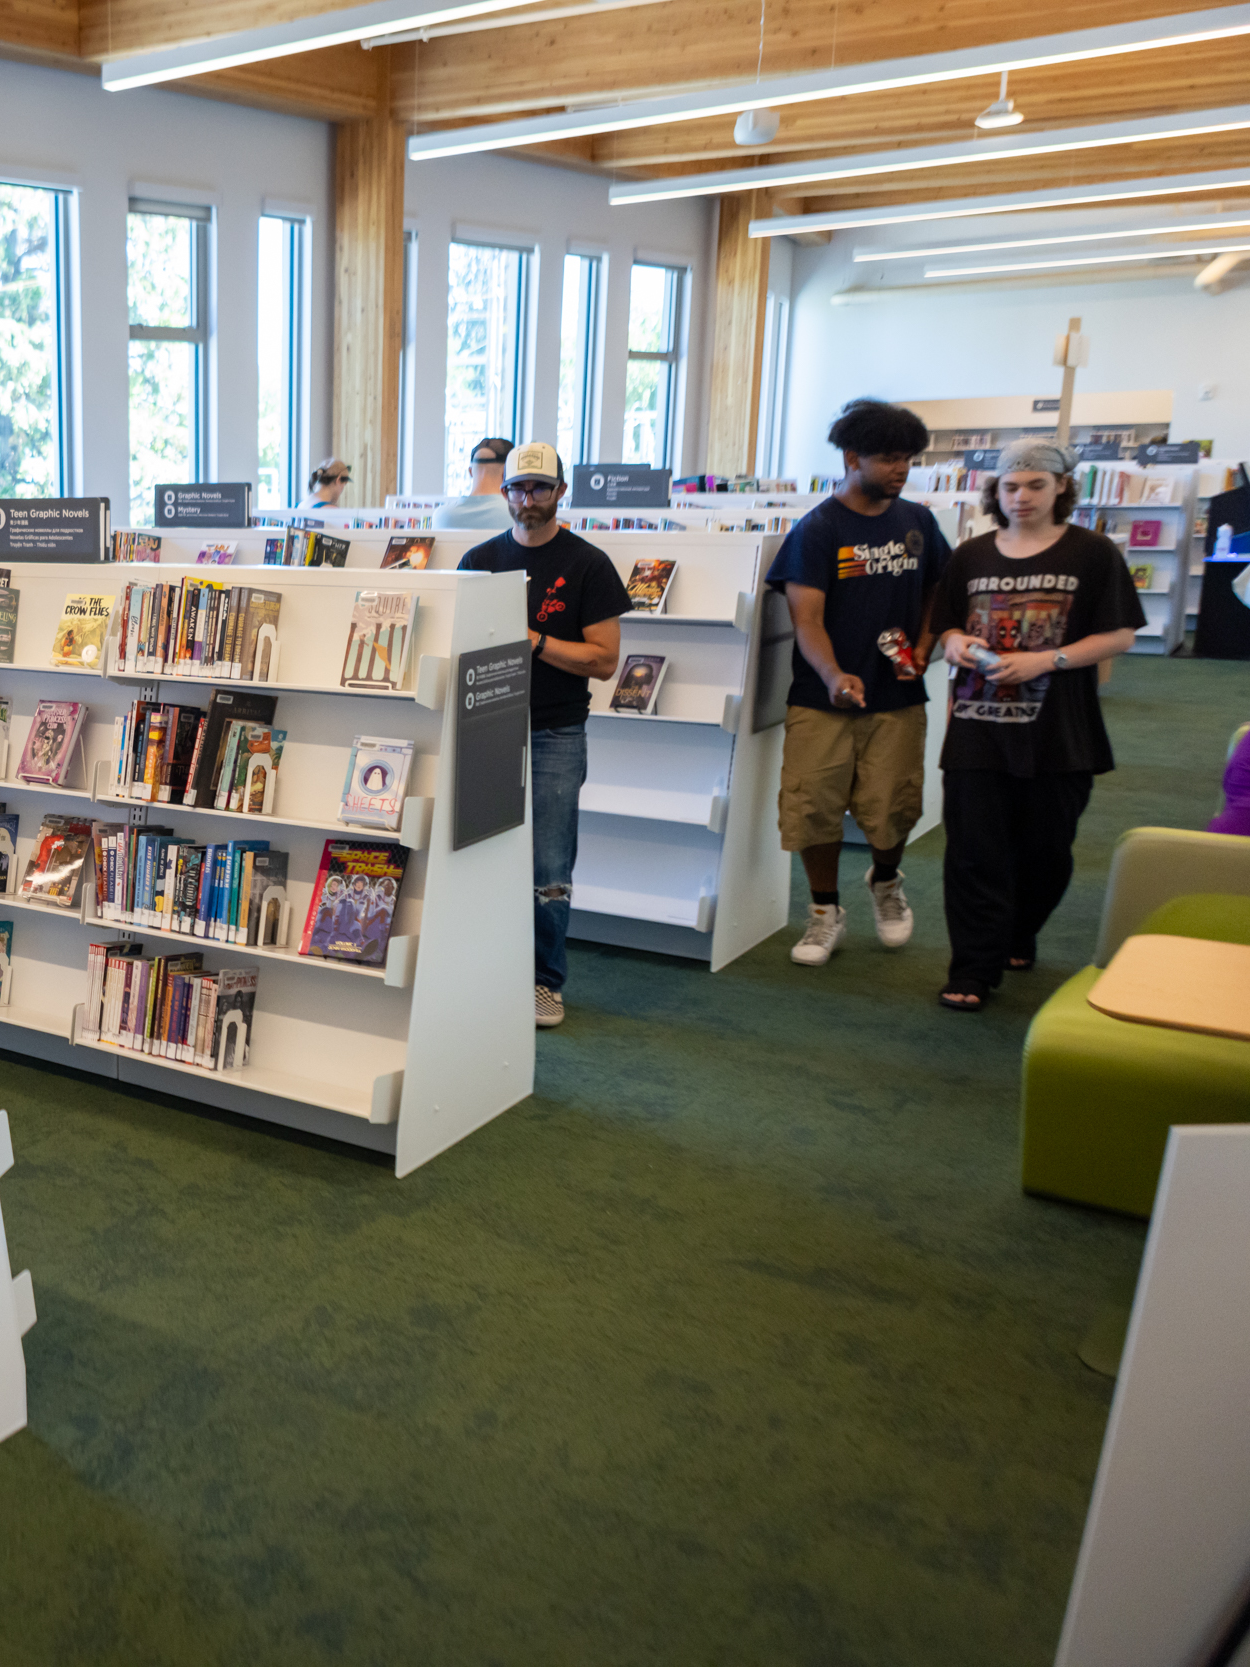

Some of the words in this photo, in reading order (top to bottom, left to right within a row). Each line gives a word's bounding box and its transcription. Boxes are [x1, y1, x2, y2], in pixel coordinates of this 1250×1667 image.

[10, 509, 28, 518] Teen
[30, 509, 60, 519] Graphic
[62, 509, 89, 518] Novels
[853, 540, 906, 561] Single
[865, 555, 918, 577] Origin
[90, 598, 104, 606] THE
[65, 605, 88, 616] CROW
[89, 607, 109, 617] FLIES
[188, 606, 196, 640] AWAKEN
[227, 613, 235, 636] COURAGE
[489, 660, 506, 671] Graphic
[508, 656, 523, 666] Novels
[476, 689, 494, 700] Graphic
[495, 685, 510, 695] Novels
[343, 794, 398, 815] SHEETS
[340, 850, 389, 863] SPACE
[346, 862, 399, 876] TRASH
